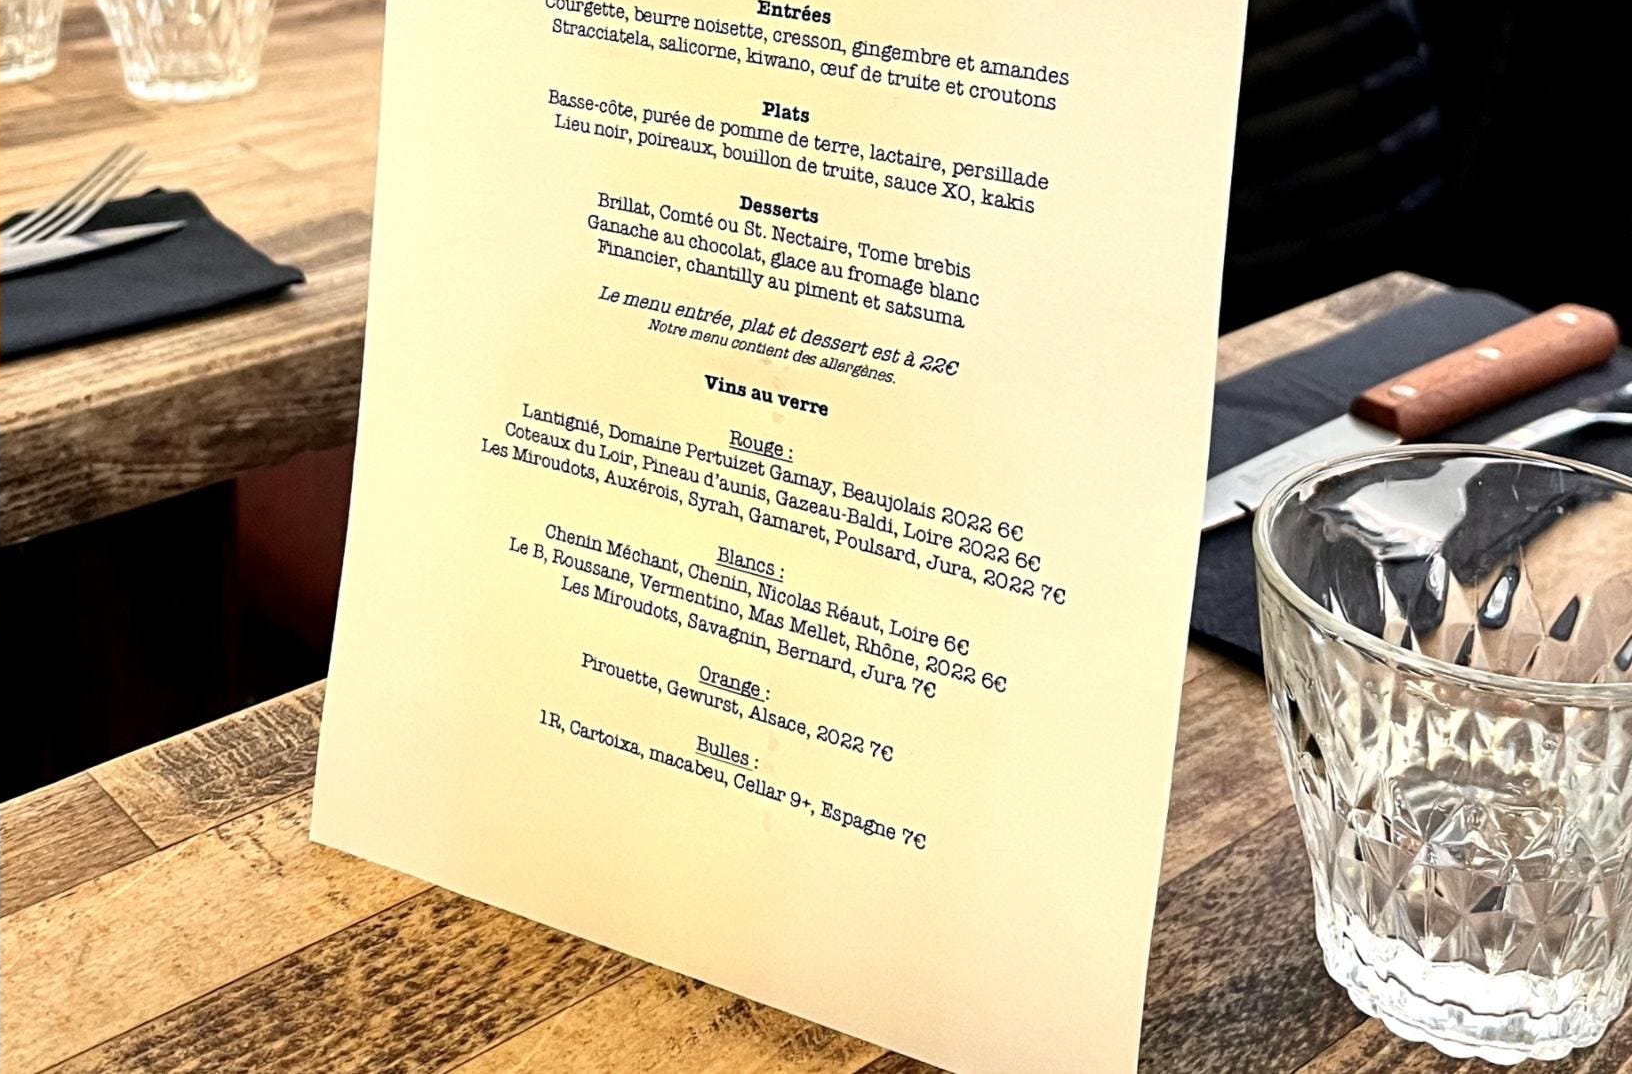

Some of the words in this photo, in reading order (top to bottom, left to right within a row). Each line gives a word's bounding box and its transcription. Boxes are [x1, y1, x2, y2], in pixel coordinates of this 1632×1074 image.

[634, 6, 690, 29] beurre
[693, 18, 768, 44] noisette,
[773, 30, 846, 56] cresson,
[852, 40, 951, 68] gingembre
[956, 55, 975, 72] et
[980, 60, 1069, 86] amandes
[757, 0, 831, 24] Entrées
[552, 18, 654, 51] Stracciatela,
[659, 36, 741, 64] salicorne,
[745, 47, 814, 76] kiwano,
[861, 65, 882, 83] de
[887, 70, 940, 92] truite
[946, 80, 964, 96] et
[969, 85, 1056, 110] croutons
[548, 89, 637, 122] Basse-côte,
[642, 109, 691, 128] purée
[695, 114, 715, 132] de
[719, 122, 784, 144] pomme
[788, 130, 809, 148] de
[814, 135, 864, 161] terre,
[869, 144, 946, 176] lactaire,
[951, 162, 1049, 190] persillade
[761, 101, 809, 123] Plats
[554, 113, 591, 134] Lieu
[594, 123, 632, 144] noir,
[636, 131, 717, 159] poireaux,
[722, 142, 792, 170] bouillon
[796, 156, 817, 174] de
[823, 161, 879, 189] truite,
[884, 175, 937, 196] sauce
[941, 181, 975, 206] XO,
[980, 188, 1035, 214] kakis
[597, 192, 655, 220] Brillat,
[659, 204, 713, 228] Comté
[718, 218, 739, 233] ou
[744, 220, 766, 239] St.
[771, 225, 852, 259] Nectaire,
[858, 242, 908, 266] Tome
[913, 252, 971, 279] brebis
[739, 195, 819, 224] Desserts
[588, 214, 659, 241] Ganache
[663, 232, 685, 246] au
[688, 235, 766, 266] chocolat,
[770, 251, 816, 273] glace
[820, 263, 843, 278] au
[847, 265, 923, 296] fromage
[929, 281, 979, 306] blanc
[597, 238, 681, 272] Financier,
[686, 258, 765, 289] chantilly
[767, 276, 789, 292] au
[794, 281, 858, 306] piment
[863, 295, 881, 311] et
[885, 301, 965, 329] satsuma
[598, 285, 620, 303] Le
[622, 294, 671, 314] menu
[675, 305, 734, 331] entrée,
[737, 317, 775, 336] plat
[779, 326, 797, 341] et
[801, 329, 869, 356] dessert
[872, 347, 901, 363] est
[903, 351, 915, 367] à
[919, 355, 960, 376] 22€
[648, 318, 687, 337] Notre
[689, 330, 729, 346] menu
[731, 339, 790, 359] contient
[792, 350, 817, 365] des
[819, 357, 895, 384] allergènes.
[704, 374, 746, 397] Vins
[751, 388, 773, 404] au
[777, 394, 828, 416] verre
[522, 403, 604, 439] Lantignié,
[608, 424, 681, 455] Domaine
[685, 442, 765, 476] Pertuizet
[770, 464, 836, 498] Gamay,
[842, 481, 935, 520] Beaujolais
[941, 507, 992, 534] 2022
[998, 522, 1023, 542] 6€
[729, 430, 784, 458] Rouge
[481, 438, 508, 458] Les
[512, 445, 599, 484] Miroudots,
[603, 470, 683, 506] Auxérois,
[688, 491, 743, 522] Syrah,
[749, 507, 830, 545] Gamaret,
[834, 529, 920, 569] Poulsard,
[926, 554, 977, 584] Jura,
[983, 569, 1035, 597] 2022
[1041, 584, 1066, 605] 7€
[505, 422, 571, 451] Coteaux
[575, 439, 595, 457] du
[599, 444, 637, 471] Loir,
[642, 455, 699, 483] Pineau
[776, 490, 898, 539] Gazeau-Baldi,
[903, 521, 953, 549] Loire
[958, 537, 1009, 564] 2022
[1015, 552, 1041, 572] 6€
[545, 524, 602, 552] Chenin
[605, 539, 683, 578] Méchant,
[688, 563, 751, 598] Chenin,
[756, 581, 821, 614] Nicolas
[825, 601, 884, 636] Réaut,
[889, 619, 939, 647] Loire
[944, 635, 969, 656] 6€
[716, 546, 775, 576] Blancs
[509, 536, 528, 555] Le
[532, 543, 547, 564] B,
[552, 548, 634, 589] Roussane,
[640, 572, 743, 620] Vermentino,
[748, 604, 784, 629] Mas
[789, 616, 850, 651] Mellet,
[855, 635, 919, 671] Rhône,
[925, 656, 976, 684] 2022
[981, 672, 1007, 693] 6€
[561, 575, 589, 597] Les
[593, 584, 682, 628] Miroudots,
[687, 613, 771, 654] Savagnin,
[776, 638, 856, 679] Bernard,
[861, 664, 906, 691] Jura
[912, 677, 936, 698] 7€
[581, 652, 662, 694] Pirouette,
[667, 680, 743, 719] Gewurst,
[748, 705, 811, 740] Alsace,
[816, 725, 864, 753] 2022
[870, 741, 893, 762] 7€
[699, 665, 761, 697] Orange
[540, 709, 565, 734] 1R,
[570, 720, 644, 760] Cartoixa,
[649, 748, 728, 788] macabeu,
[734, 773, 786, 802] Cellar
[790, 791, 815, 816] 9+,
[820, 800, 896, 840] Espagne
[902, 828, 926, 850] 7€
[696, 735, 749, 766] Bulles
